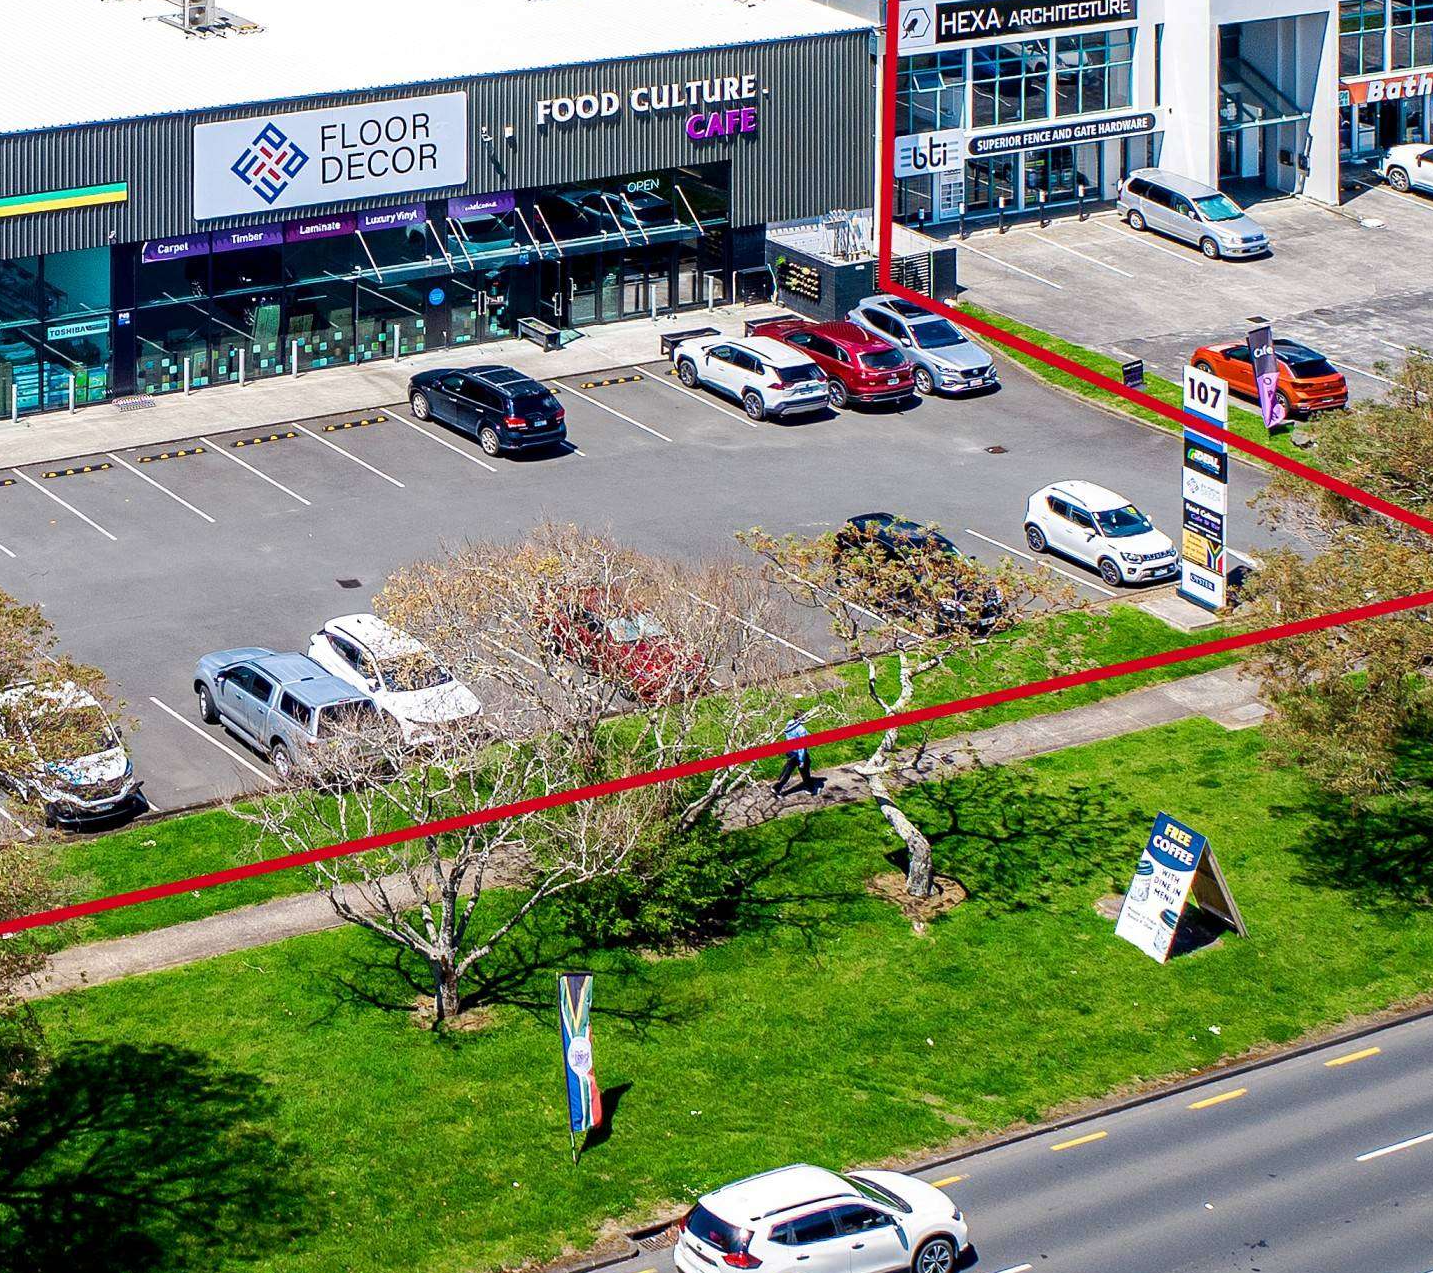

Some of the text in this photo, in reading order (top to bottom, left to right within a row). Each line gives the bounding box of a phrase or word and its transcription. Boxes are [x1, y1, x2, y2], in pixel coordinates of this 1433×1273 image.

[941, 8, 1001, 36] HEXA
[537, 74, 757, 125] FOOD CULTURE
[320, 113, 430, 152] FLOOR
[685, 107, 757, 139] CAFE
[977, 117, 1148, 151] SUPERIOR FENCE AND GATE HARDWARE
[320, 143, 438, 185] DECOR
[913, 137, 947, 169] bti
[627, 178, 660, 193] OPEN
[299, 221, 341, 235] Laminate
[365, 209, 418, 226] Luxury Vinyl
[157, 241, 189, 256] Carpet
[231, 231, 264, 244] Timber
[50, 325, 86, 337] TOSHIBA
[1254, 346, 1273, 357] Cafe
[1189, 377, 1221, 408] 107
[1164, 823, 1192, 847] FREE
[1153, 835, 1195, 866] COFFEE
[1154, 876, 1181, 897] DINE IN
[1161, 868, 1180, 884] WITH
[1154, 889, 1175, 905] MENU
